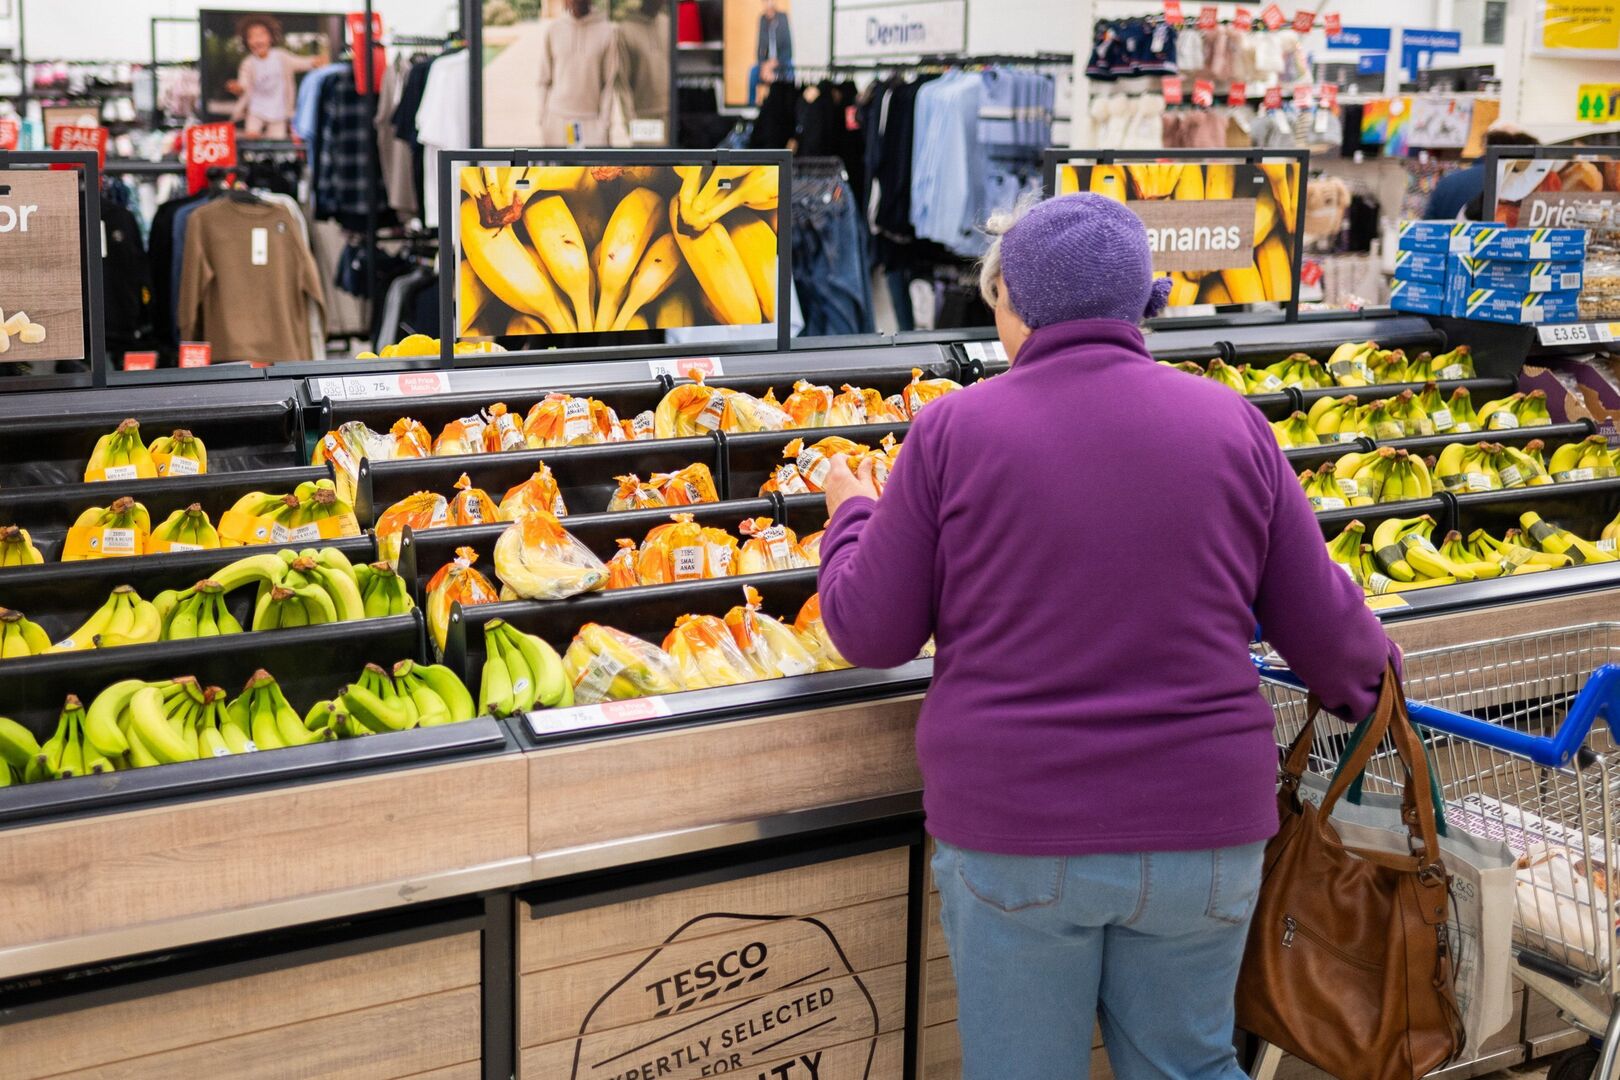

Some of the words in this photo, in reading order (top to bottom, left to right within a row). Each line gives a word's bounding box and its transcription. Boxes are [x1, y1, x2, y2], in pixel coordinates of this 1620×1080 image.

[866, 14, 926, 45] Denim
[62, 127, 100, 144] SALE
[192, 126, 228, 143] SALE
[1529, 199, 1590, 227] Drie
[1554, 326, 1587, 341] £3.65
[645, 941, 768, 1007] TESCO
[608, 1036, 712, 1080] PERTLY
[721, 987, 834, 1049] SELECTED
[701, 1052, 743, 1077] FOR
